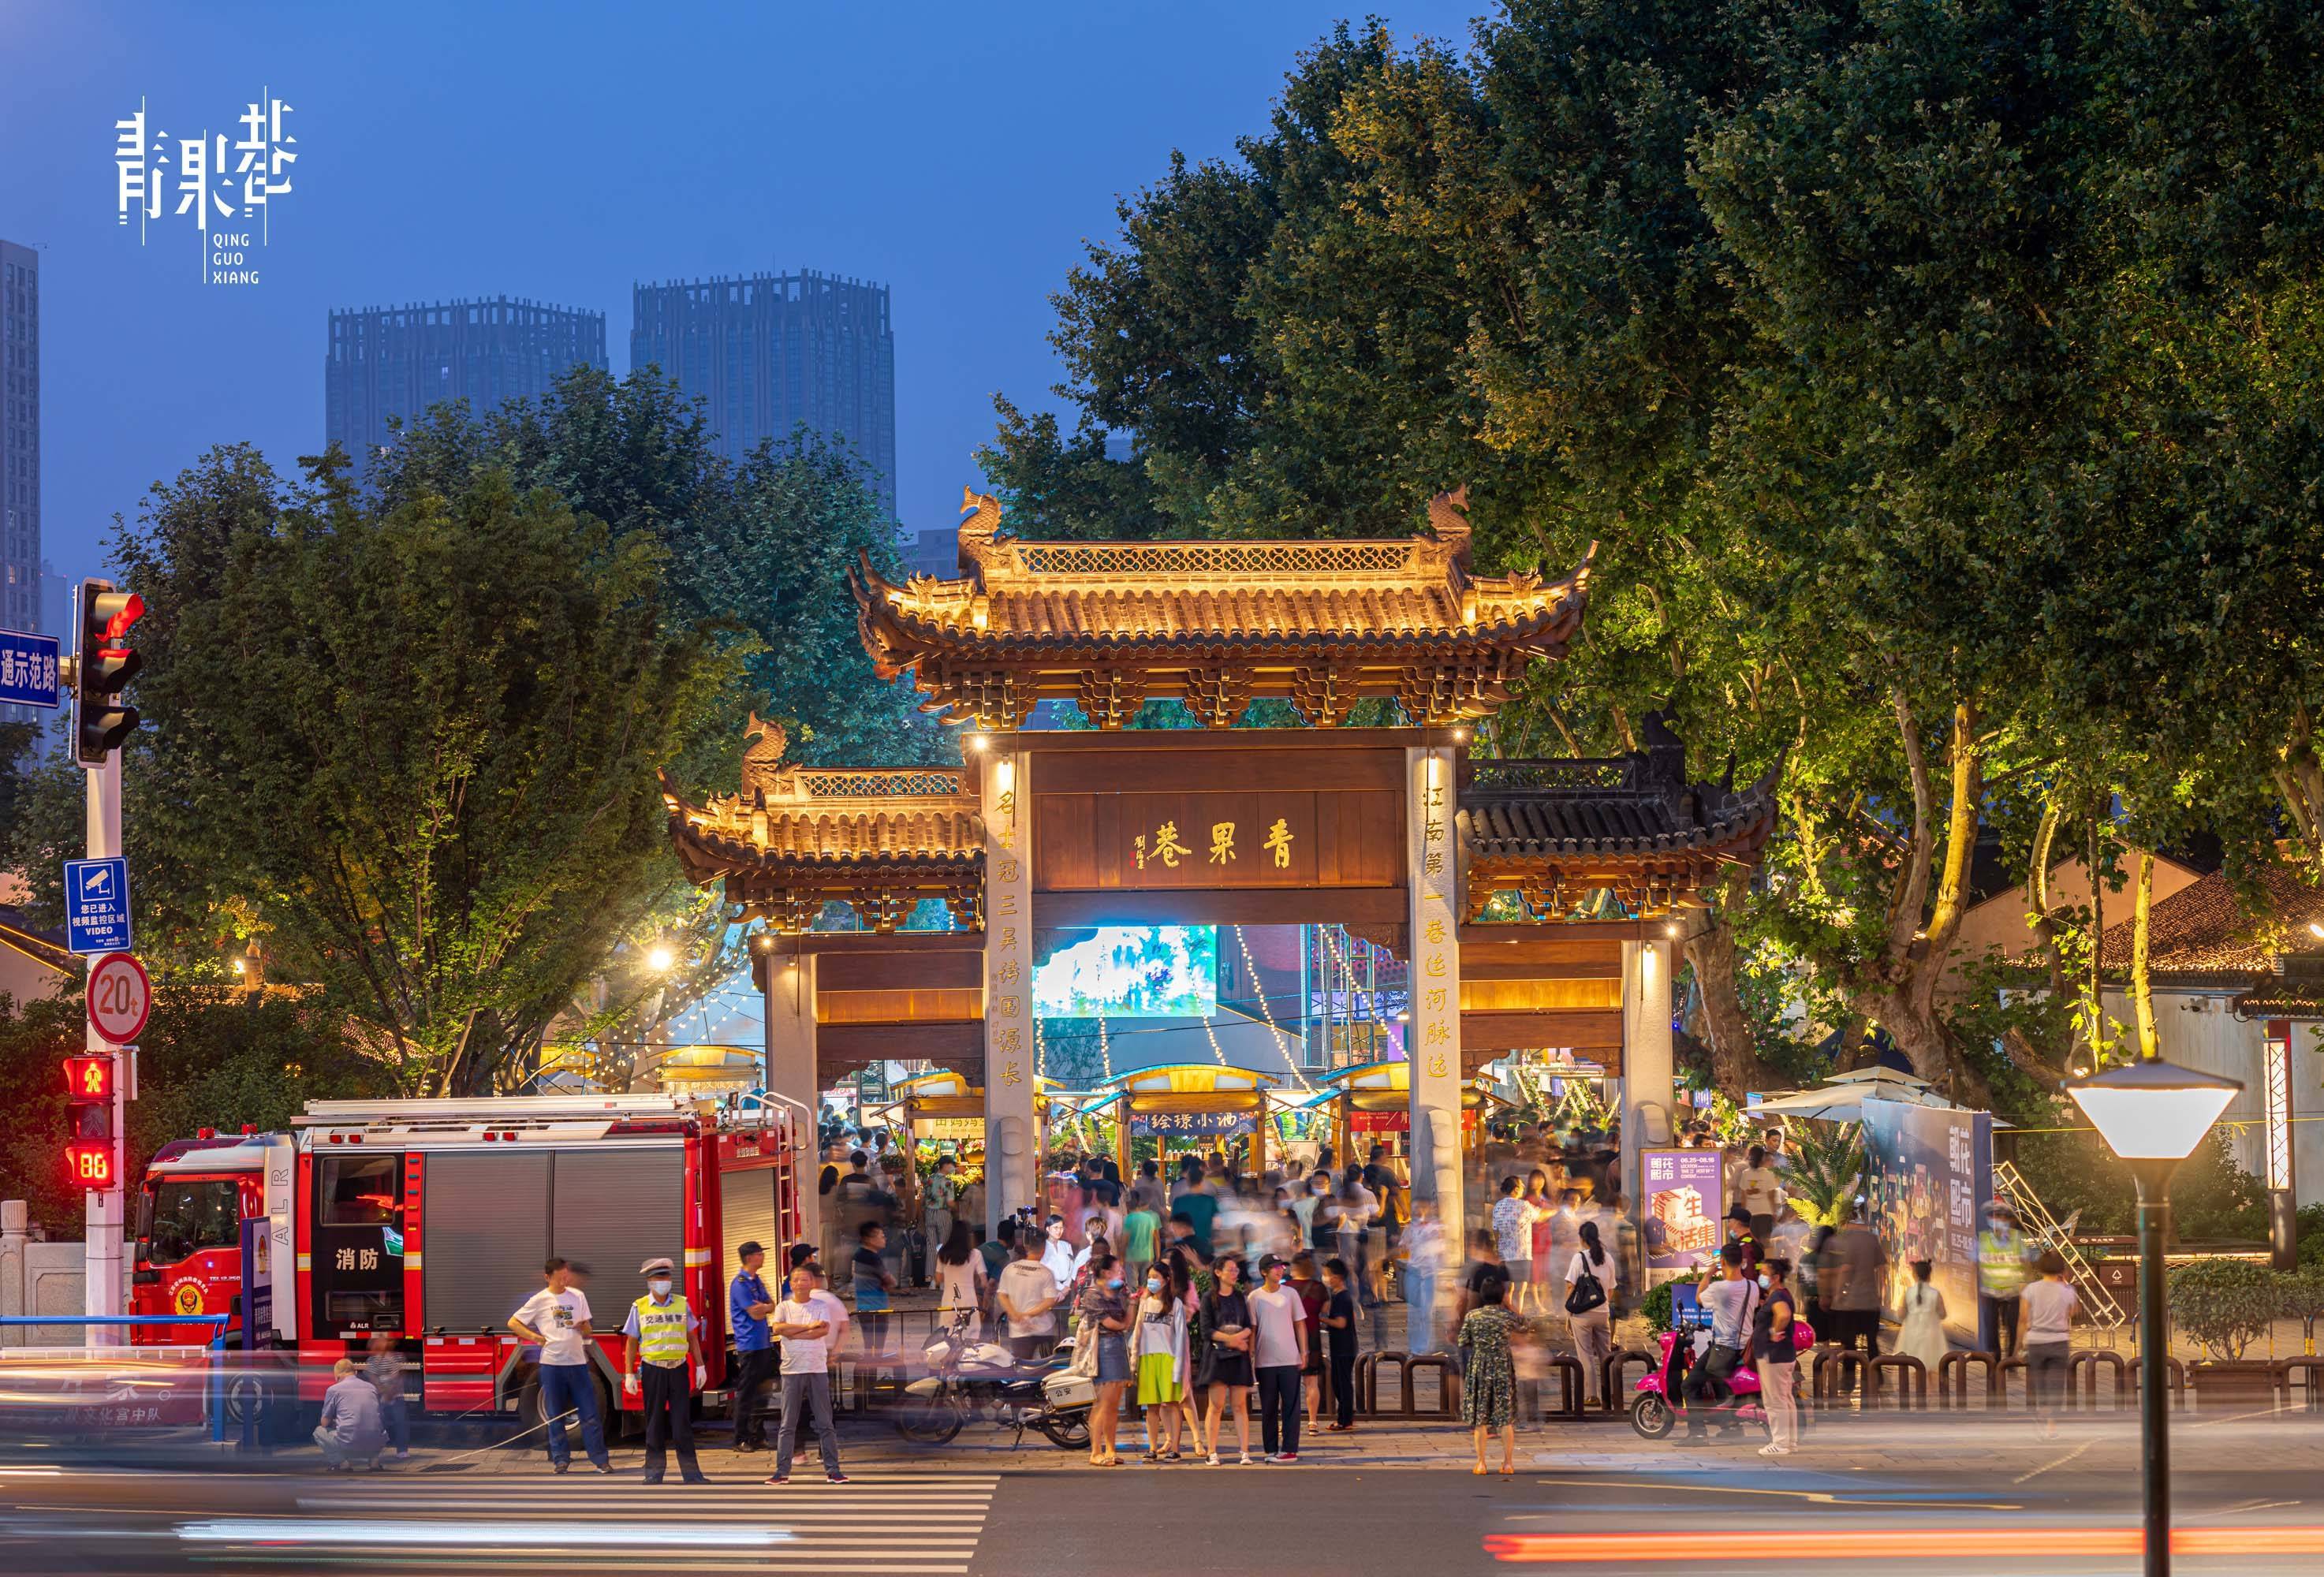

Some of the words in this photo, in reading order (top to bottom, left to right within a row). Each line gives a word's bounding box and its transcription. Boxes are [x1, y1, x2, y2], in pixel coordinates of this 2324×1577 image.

[1, 648, 56, 693] 通示范路
[1146, 818, 1294, 869] 青果巷
[72, 913, 125, 926] 视频监控区域
[80, 903, 116, 914] 您已进入
[85, 926, 113, 936] VIDEO
[99, 974, 138, 1016] 20t
[270, 1169, 289, 1246] ALR
[336, 1248, 379, 1270] 消防
[1055, 1387, 1072, 1397] 公安
